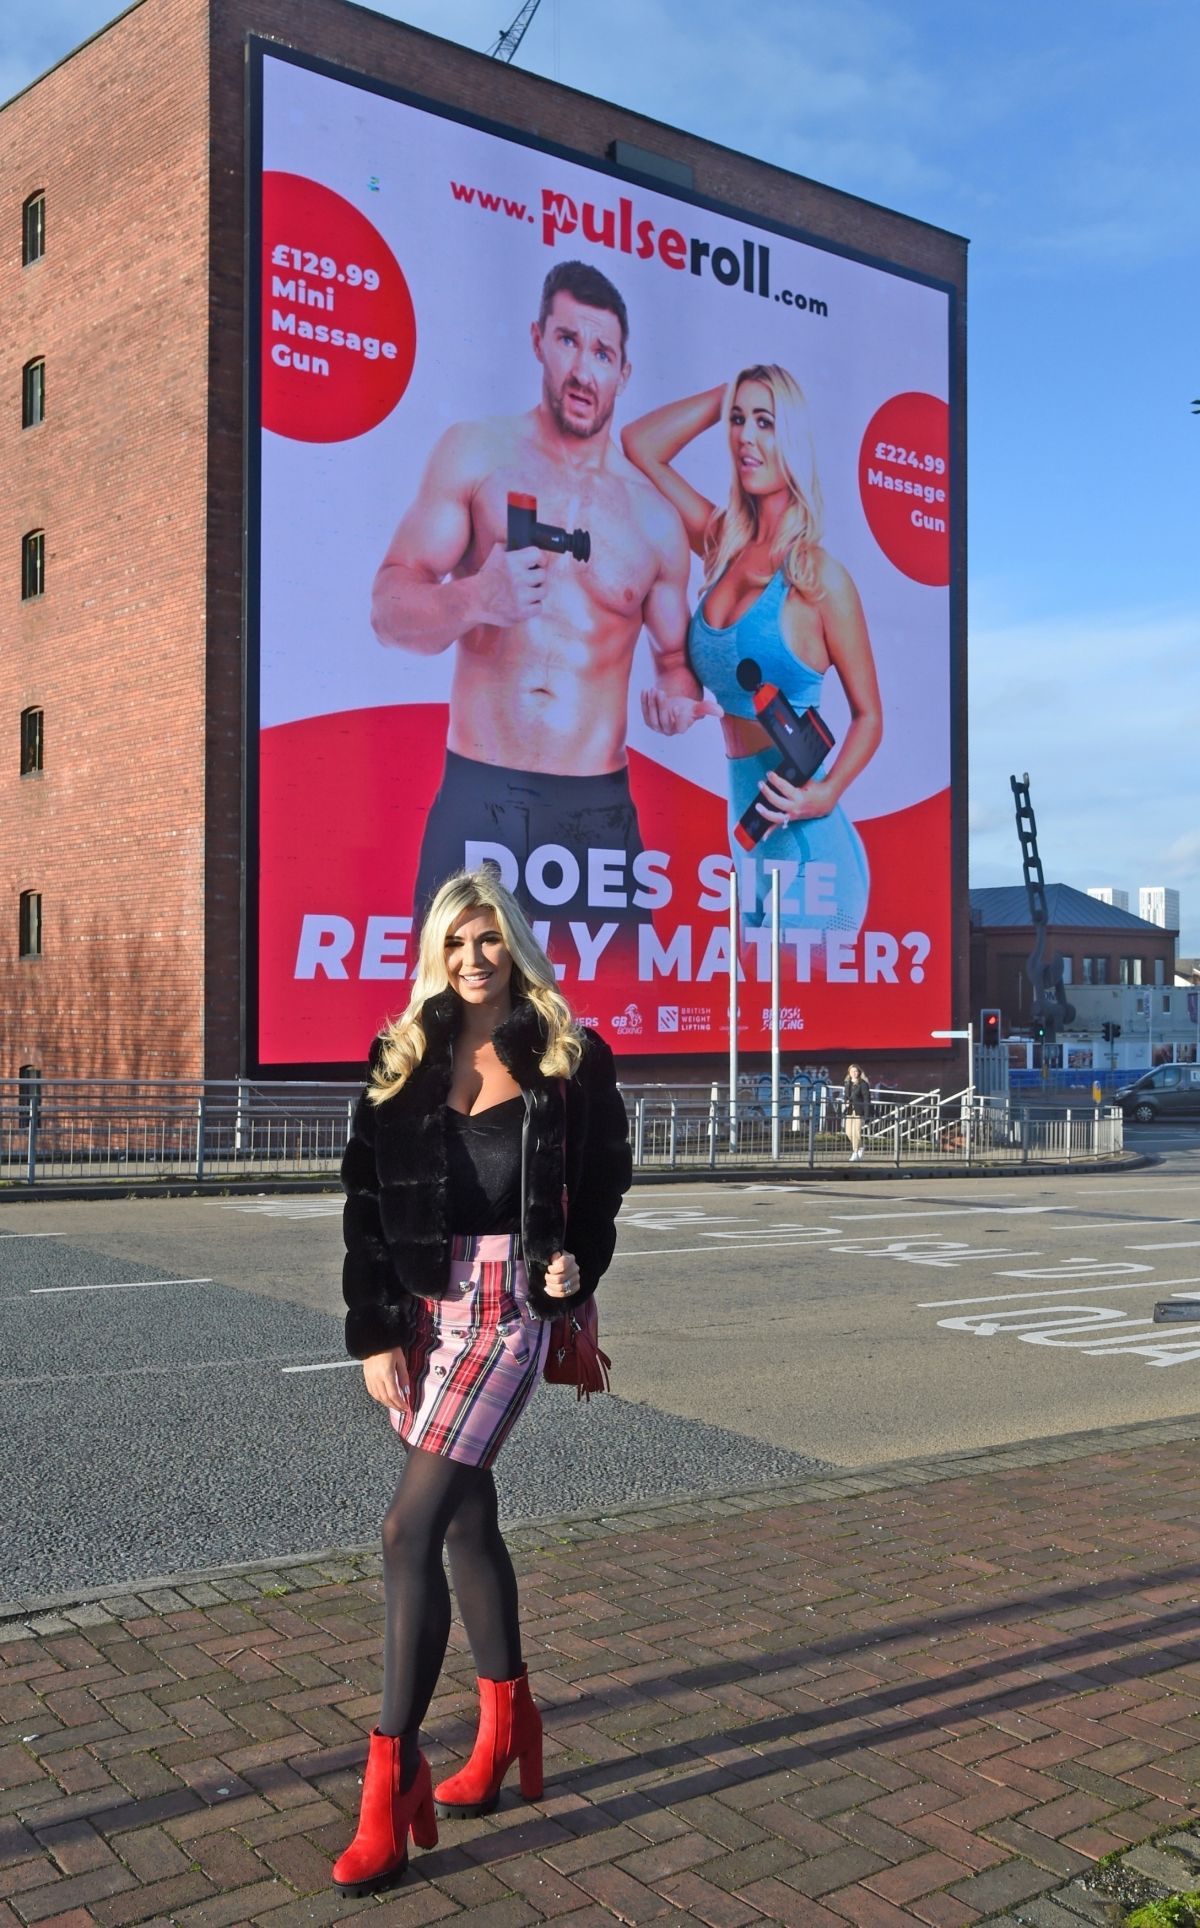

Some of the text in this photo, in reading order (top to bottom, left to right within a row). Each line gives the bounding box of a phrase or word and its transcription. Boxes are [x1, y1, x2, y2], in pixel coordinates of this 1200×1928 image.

[271, 244, 380, 291] £129.99
[272, 275, 335, 311] Mini
[272, 309, 398, 360] Massage
[271, 343, 330, 377] Gun
[875, 442, 945, 475] £224.99
[868, 468, 946, 504] Massage
[911, 510, 946, 533] Gun
[697, 854, 838, 916] SIZE
[294, 914, 931, 984] RELY MATTER?
[611, 1015, 628, 1028] GB
